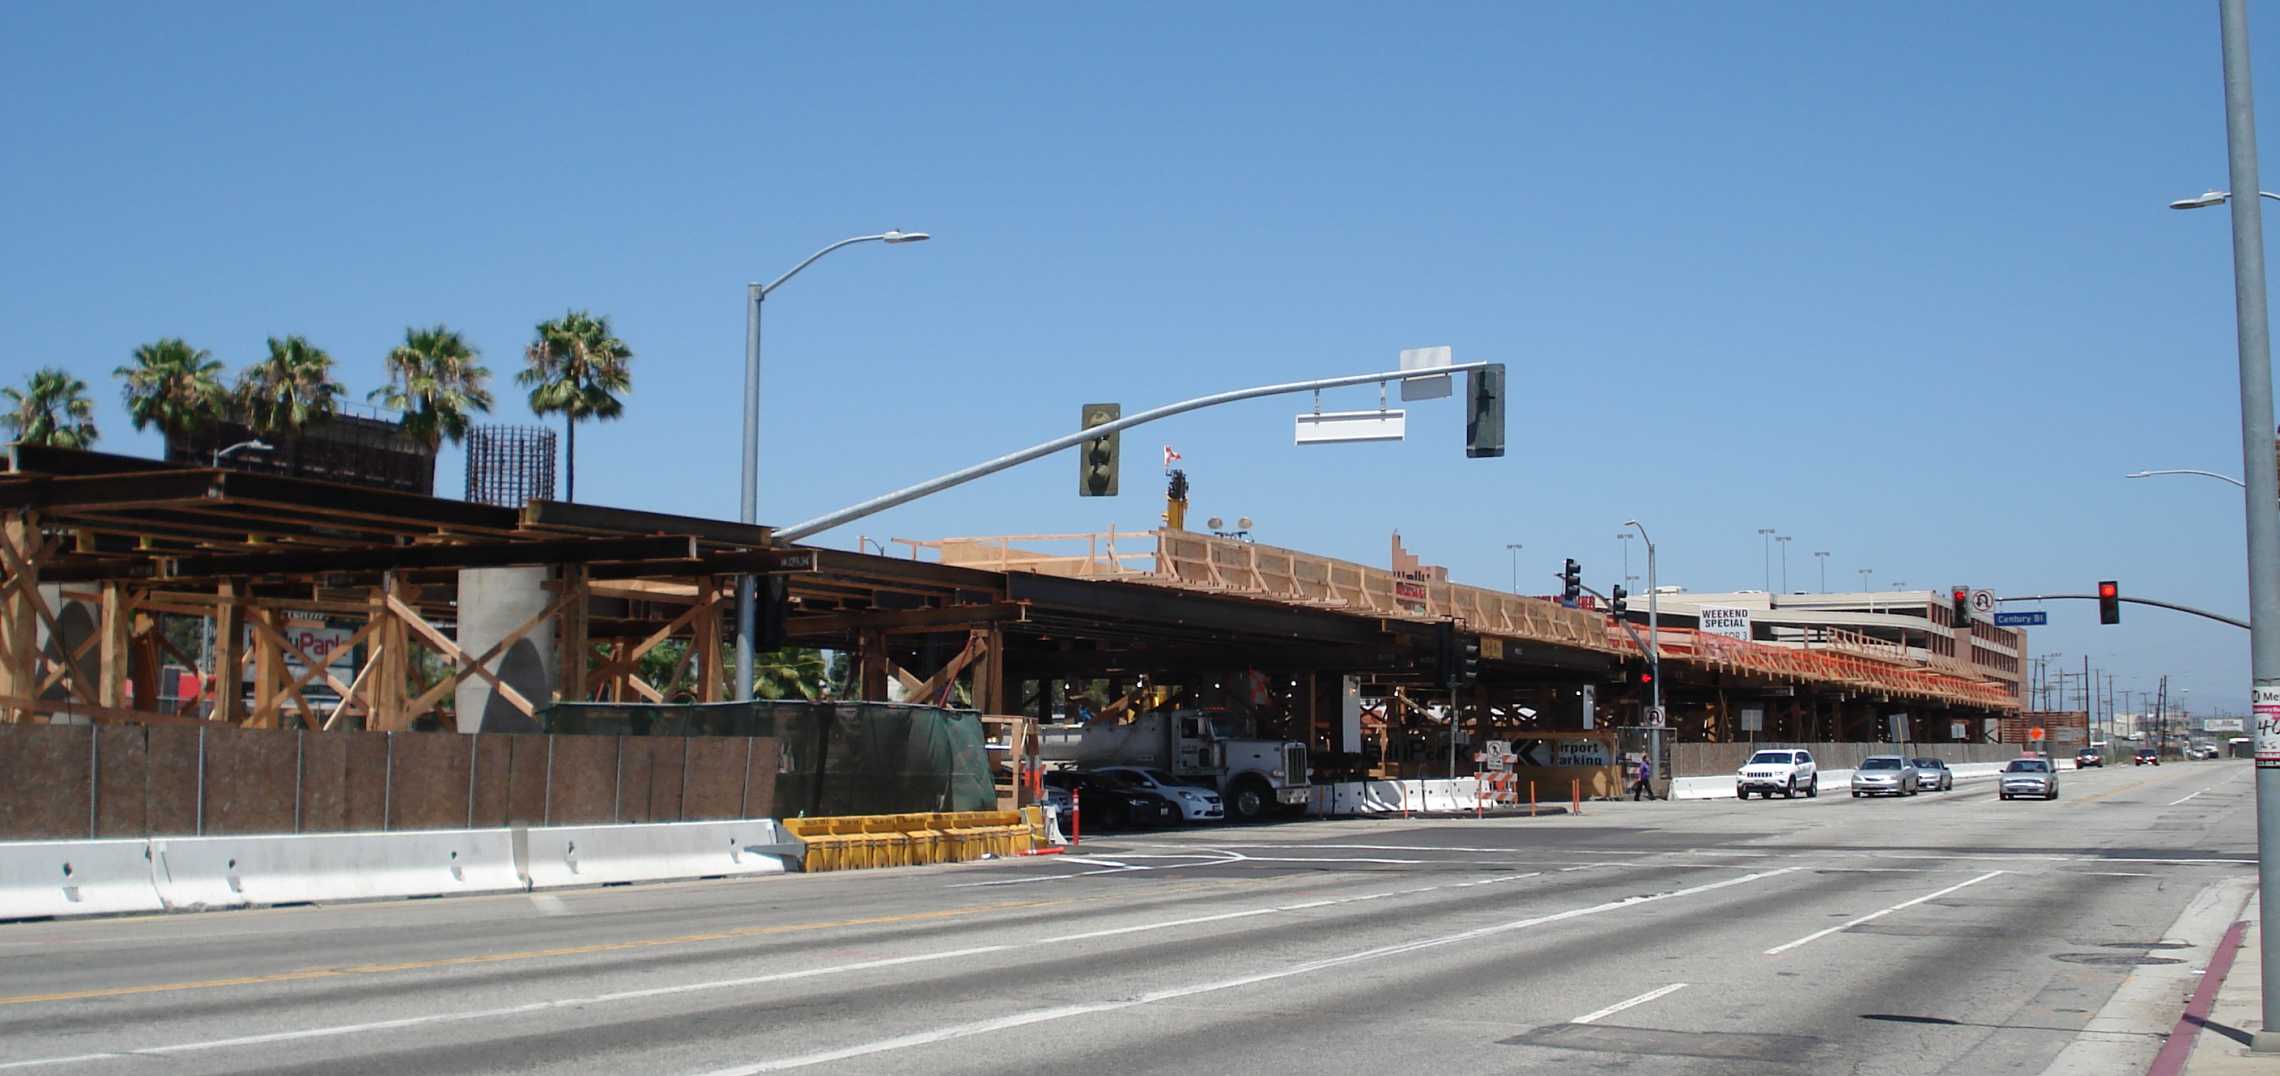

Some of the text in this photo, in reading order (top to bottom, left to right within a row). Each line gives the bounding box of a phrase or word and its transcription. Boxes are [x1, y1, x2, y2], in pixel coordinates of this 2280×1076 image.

[1702, 609, 1748, 618] WEEKEND
[1705, 619, 1745, 628] SPECIAL
[1559, 743, 1599, 755] irport
